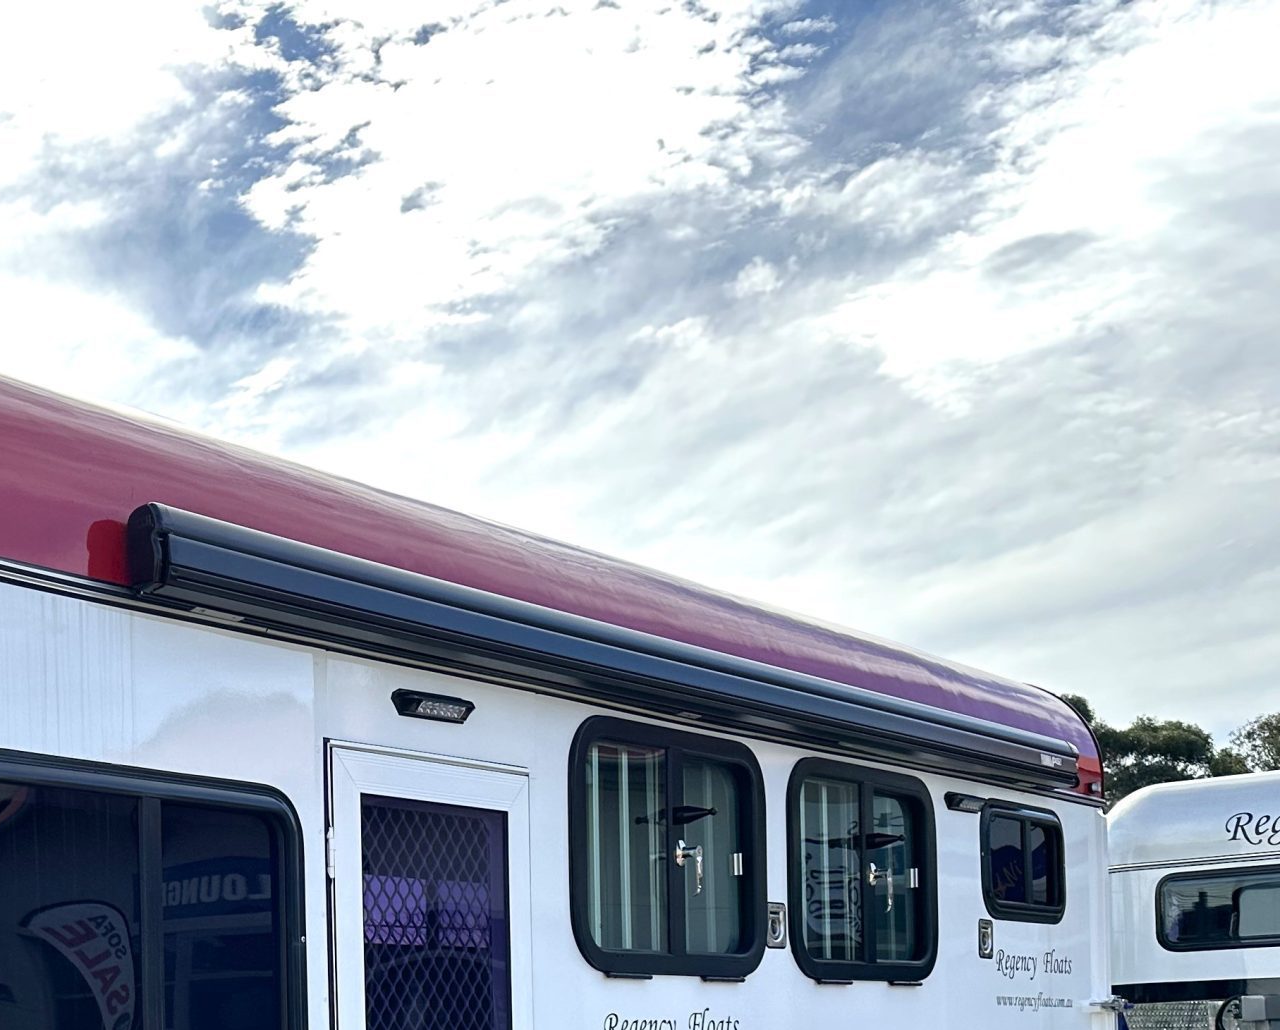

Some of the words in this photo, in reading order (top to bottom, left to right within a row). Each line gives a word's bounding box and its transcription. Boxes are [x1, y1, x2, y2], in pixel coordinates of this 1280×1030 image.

[996, 949, 1037, 980] Regency
[1043, 949, 1072, 975] Floats
[996, 992, 1073, 1012] www.regencyfloats.com.au
